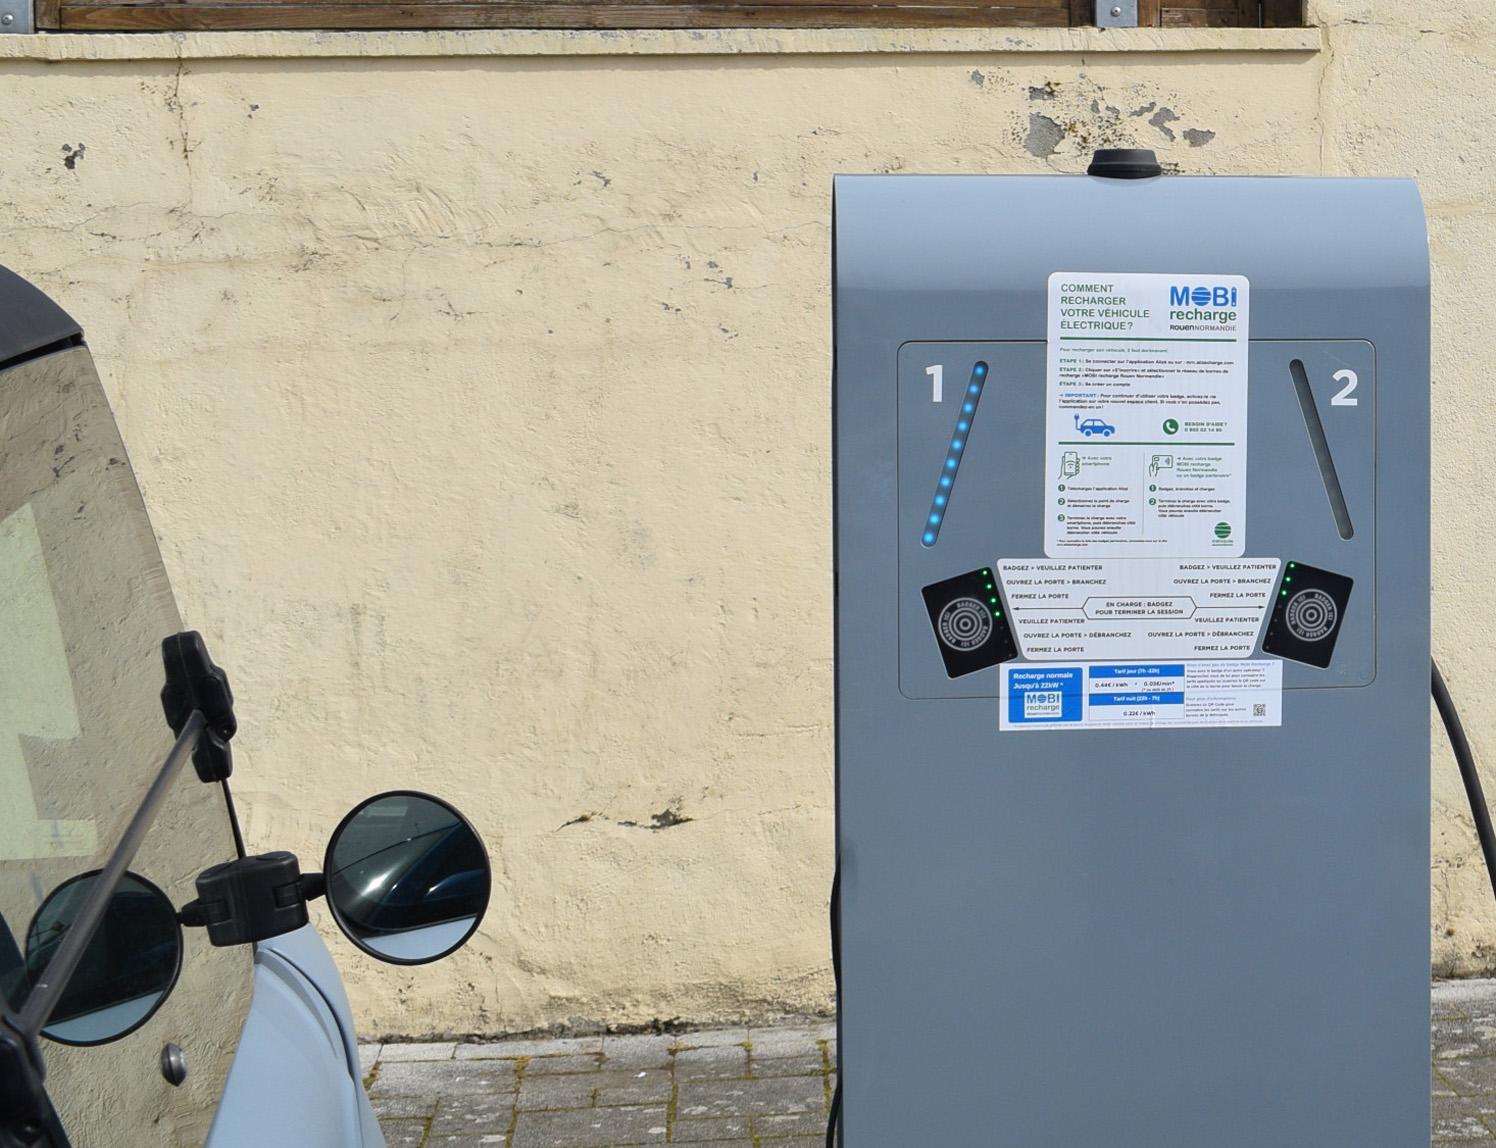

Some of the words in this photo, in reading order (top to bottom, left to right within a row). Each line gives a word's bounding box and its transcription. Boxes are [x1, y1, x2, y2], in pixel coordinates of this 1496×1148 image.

[1061, 283, 1114, 293] COMMENT
[1060, 296, 1126, 305] RECHARGER
[1170, 286, 1237, 307] MOBI
[1060, 308, 1095, 317] VOTRE
[1098, 306, 1150, 318] VÉHICULE
[1170, 307, 1237, 324] recharge
[926, 364, 943, 402] 1
[1331, 368, 1358, 406] 2
[1013, 672, 1045, 680] Recharge
[1013, 682, 1040, 690] Jusqu'à
[1026, 694, 1060, 704] MOBI
